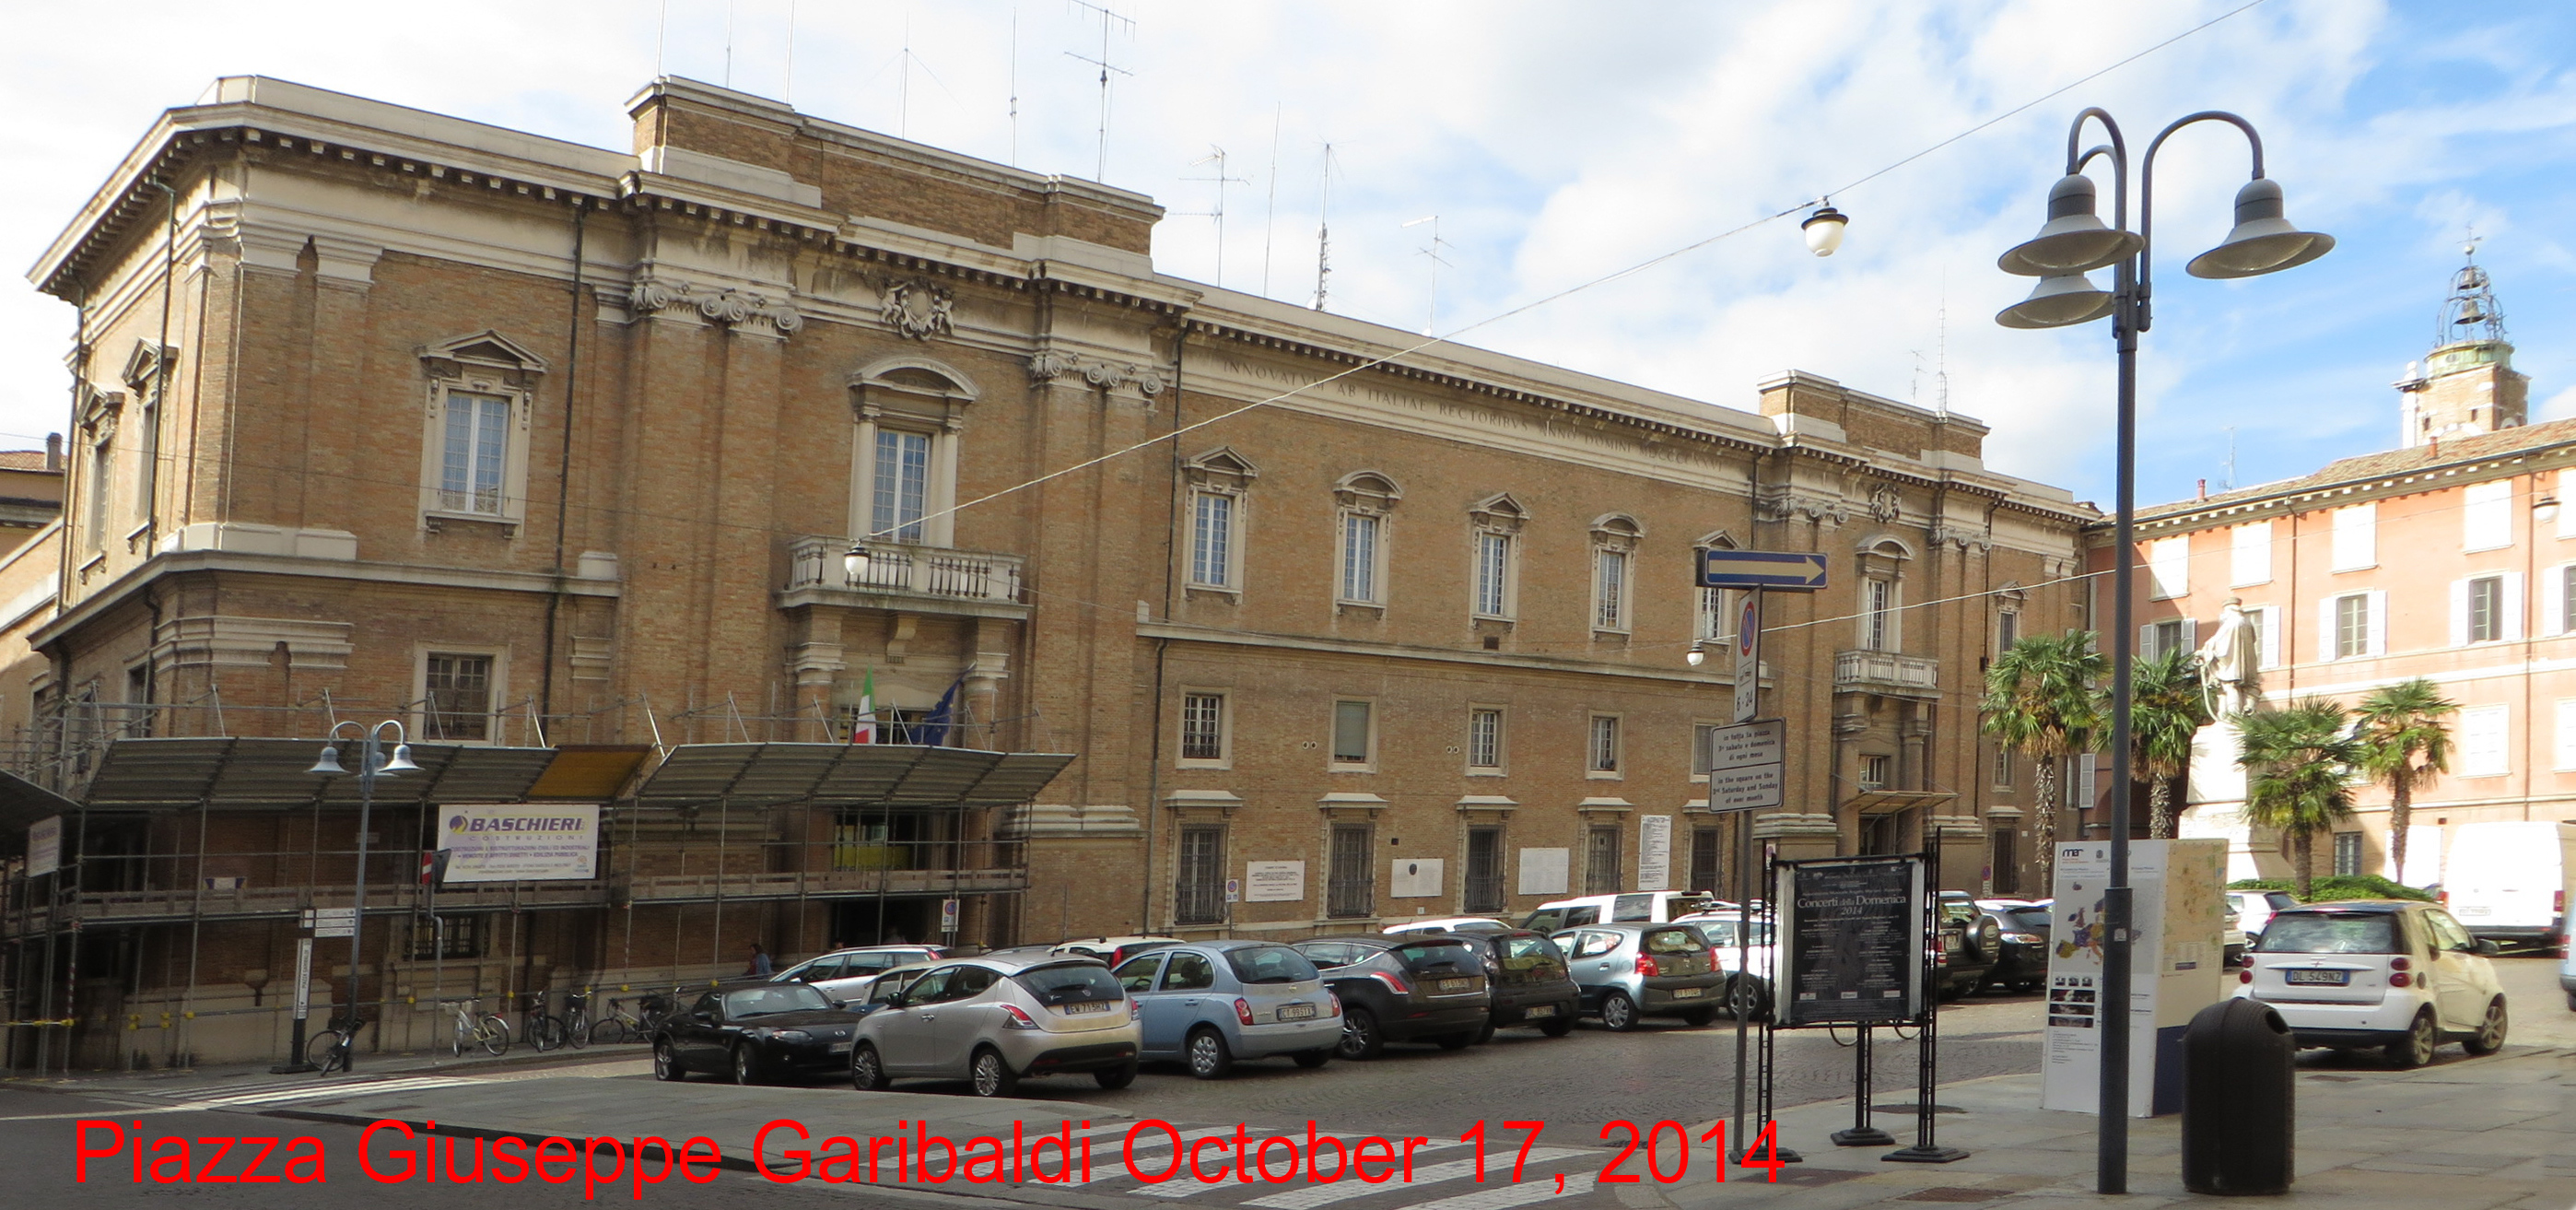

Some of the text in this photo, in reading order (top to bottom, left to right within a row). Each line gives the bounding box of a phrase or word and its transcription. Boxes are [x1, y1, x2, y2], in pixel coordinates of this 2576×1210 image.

[1337, 383, 1356, 397] AB
[1368, 388, 1426, 411] ITALIAE
[1439, 403, 1528, 431] RECTORIBVS
[1722, 785, 1745, 793] Saturday
[470, 817, 582, 832] BASCHIERI
[1797, 897, 1838, 909] Concerti
[1856, 894, 1906, 906] Domenica
[1841, 907, 1863, 915] 2014
[2309, 972, 2341, 982] 549NZ
